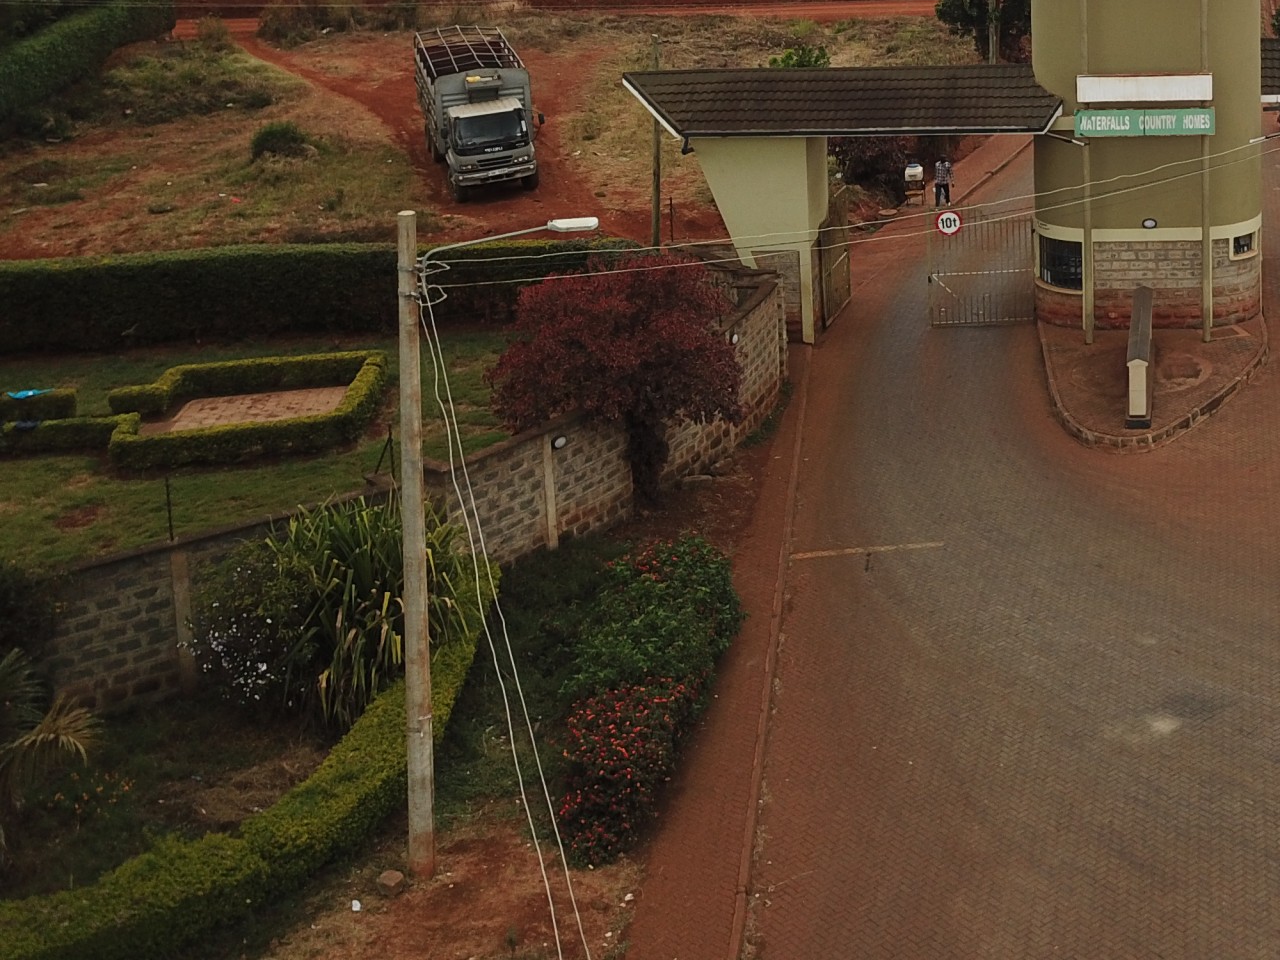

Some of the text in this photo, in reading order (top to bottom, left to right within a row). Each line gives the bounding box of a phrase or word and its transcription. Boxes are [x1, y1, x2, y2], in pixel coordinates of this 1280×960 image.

[1138, 114, 1176, 130] COUNTRY
[1182, 113, 1210, 129] HOMES
[940, 217, 957, 229] 10t
